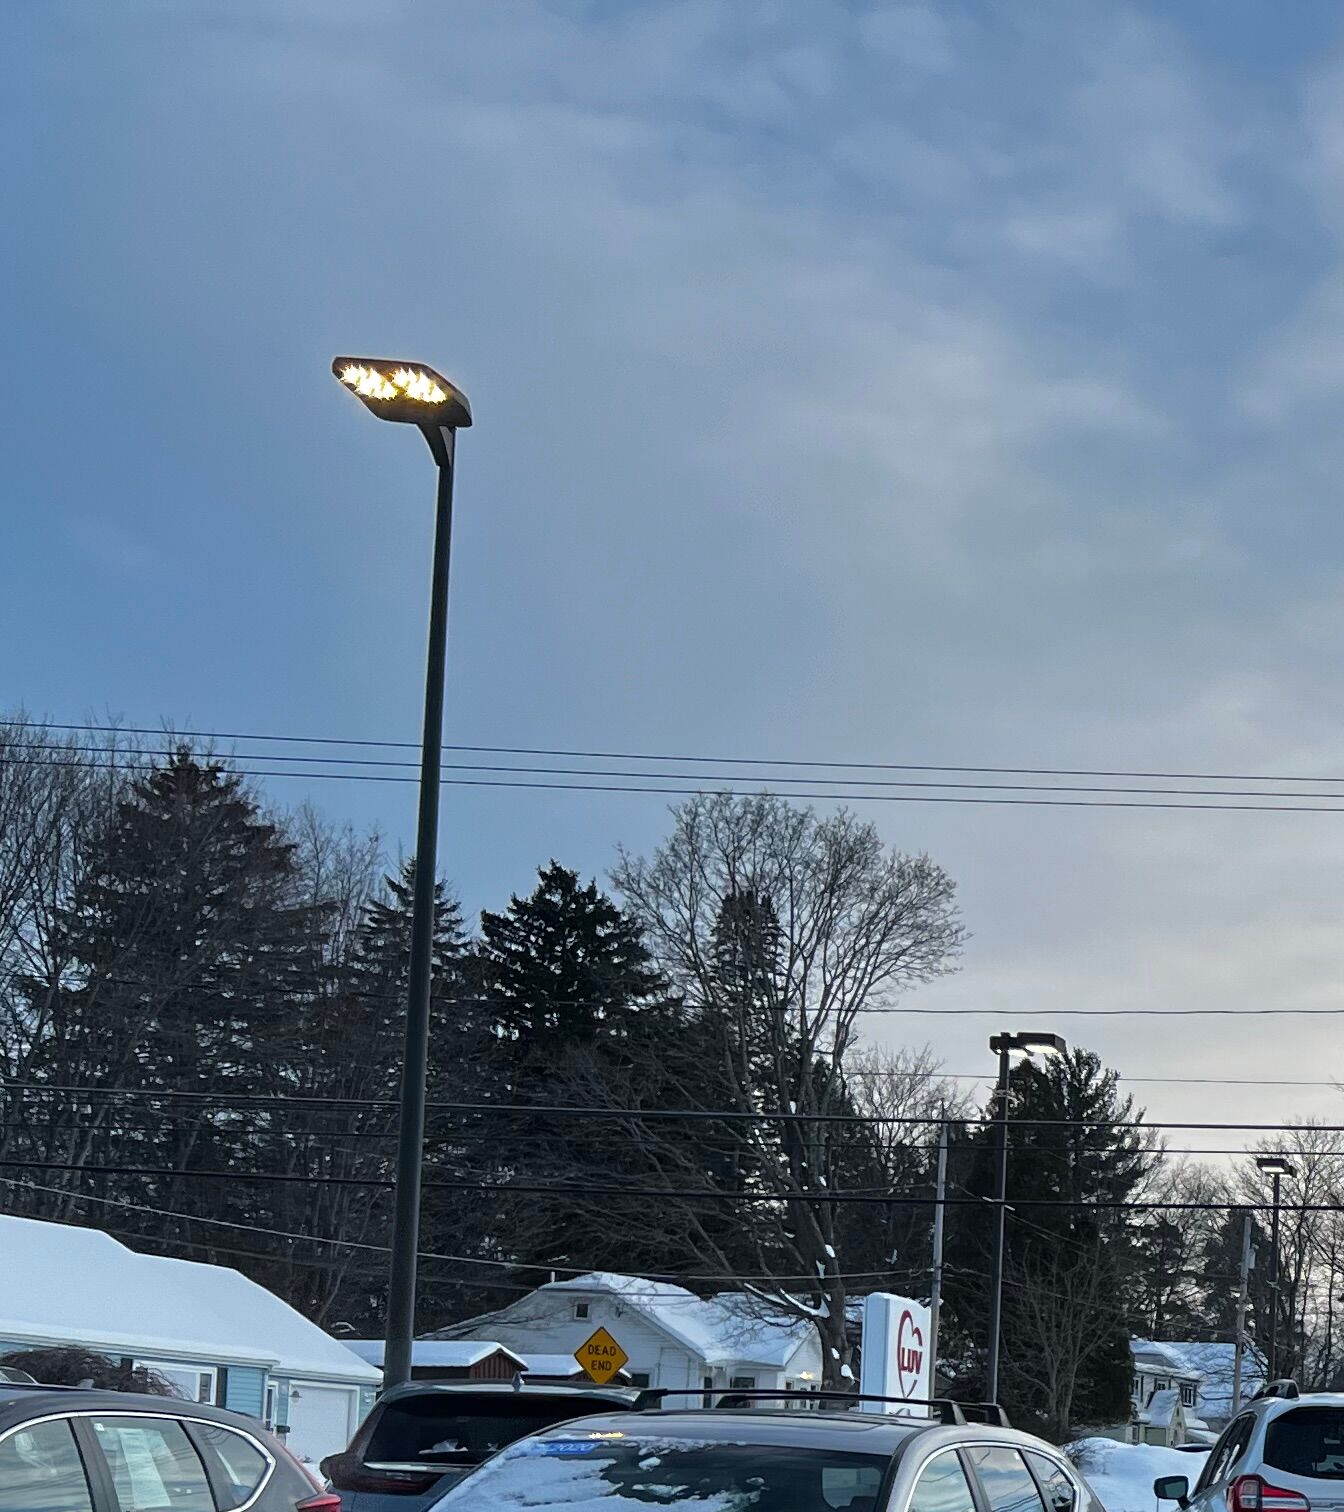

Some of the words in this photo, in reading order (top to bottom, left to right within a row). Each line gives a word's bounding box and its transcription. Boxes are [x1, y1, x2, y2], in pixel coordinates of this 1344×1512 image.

[588, 1344, 616, 1356] DEAD
[591, 1360, 612, 1371] END
[901, 1347, 922, 1374] LUV
